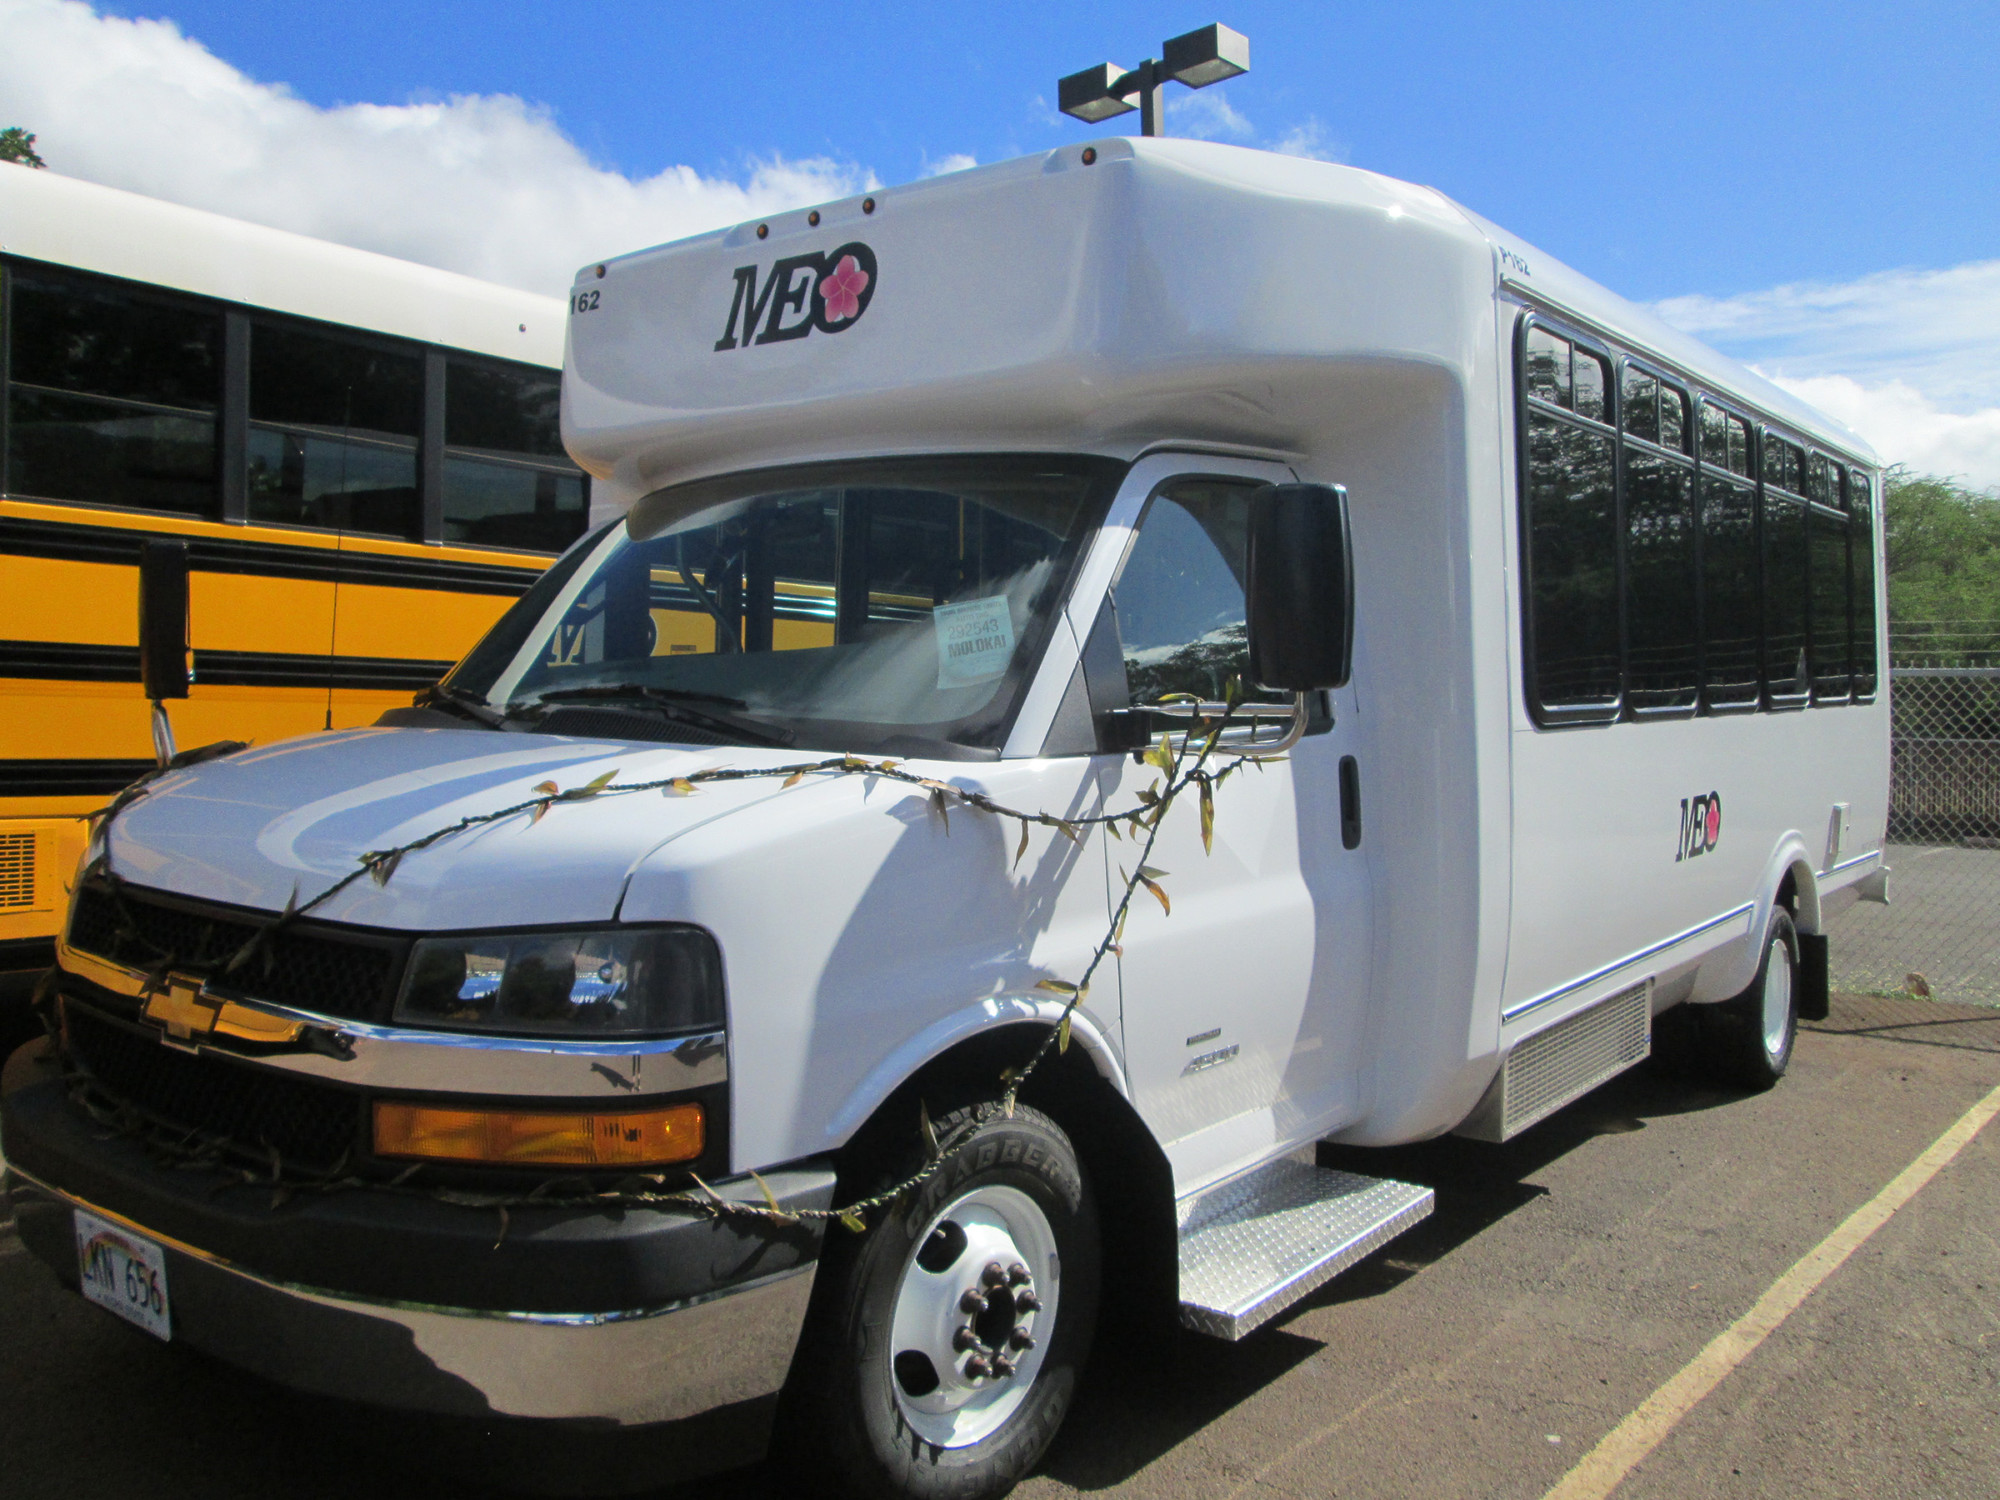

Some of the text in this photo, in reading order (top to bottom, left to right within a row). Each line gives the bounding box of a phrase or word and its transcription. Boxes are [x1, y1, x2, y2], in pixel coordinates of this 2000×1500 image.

[714, 241, 878, 352] MEO
[947, 634, 1007, 659] MOLOKAI
[948, 618, 999, 640] 292543
[1675, 790, 1721, 862] MEO
[906, 1139, 1063, 1240] GRABBER
[126, 1258, 162, 1315] 656
